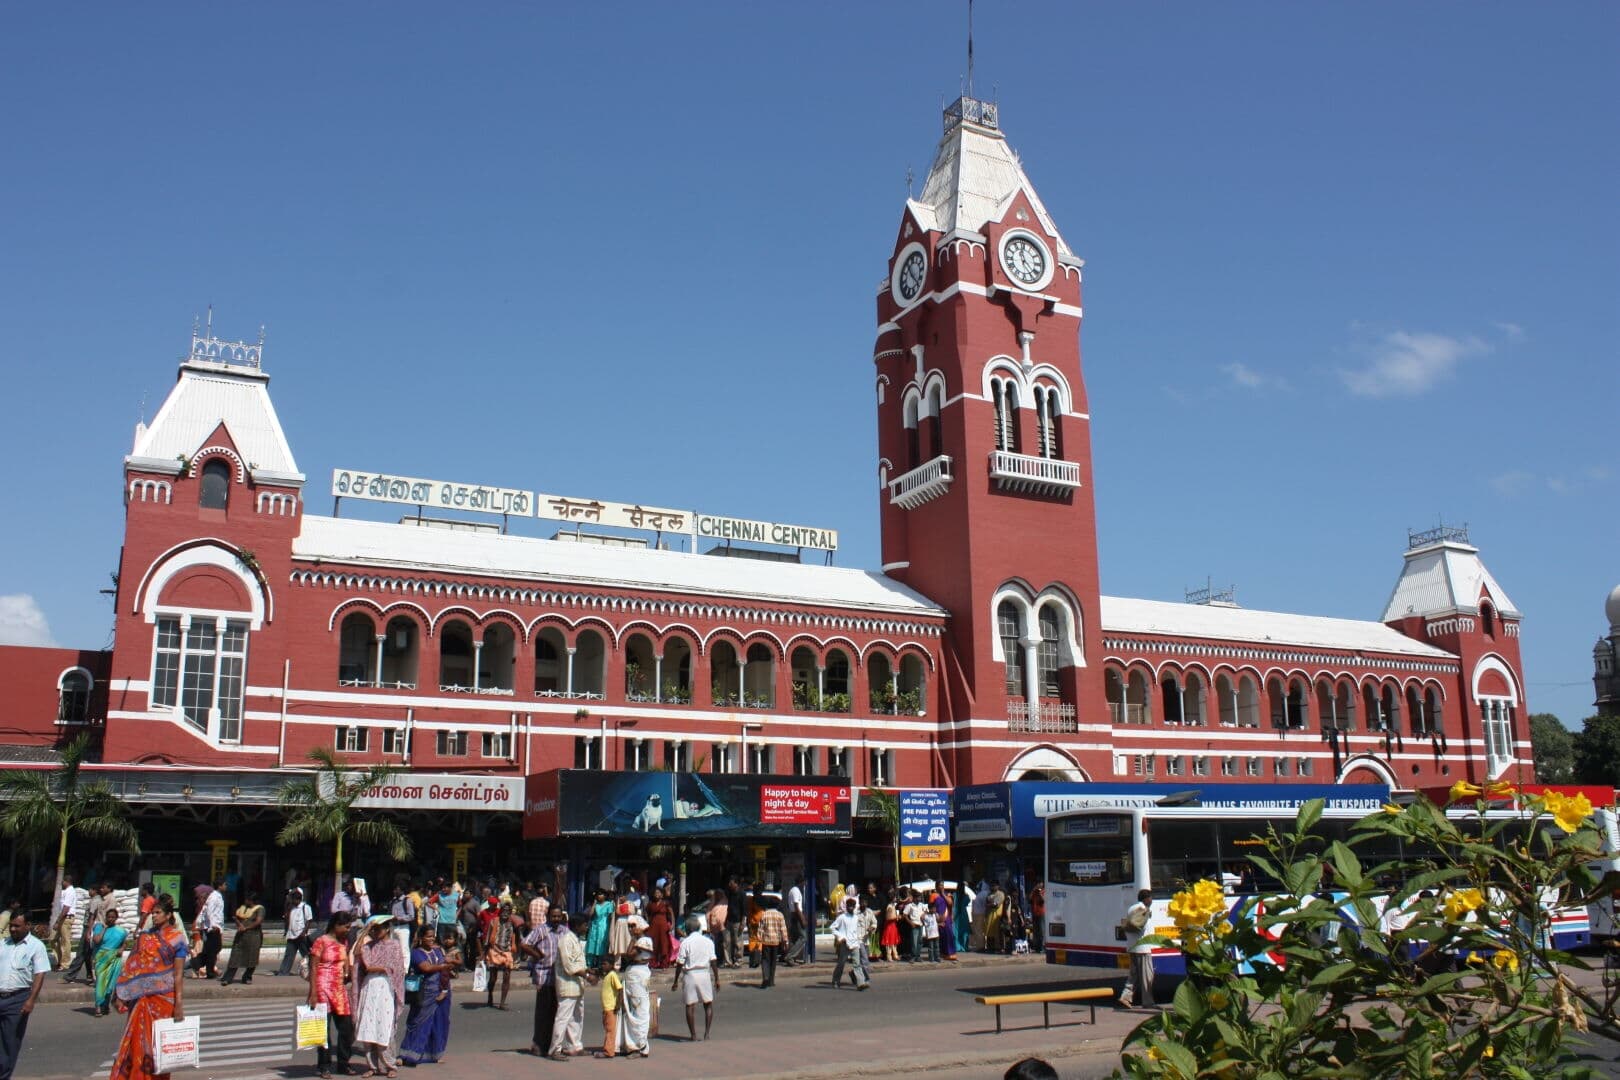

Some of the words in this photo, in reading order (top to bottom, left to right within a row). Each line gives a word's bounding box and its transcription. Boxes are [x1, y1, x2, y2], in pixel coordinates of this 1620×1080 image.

[338, 472, 433, 502] சென்னை
[441, 483, 529, 514] சென்ட்ரல்
[700, 517, 765, 541] CHENNAI
[771, 524, 836, 549] CENTRAL
[429, 782, 509, 804] சென்ட்ரல்
[764, 788, 790, 799] Happy
[791, 789, 799, 797] to
[800, 788, 818, 799] help
[764, 799, 786, 809] night
[787, 799, 793, 808] &
[795, 799, 809, 809] day
[1330, 799, 1381, 809] NEWSPAPER
